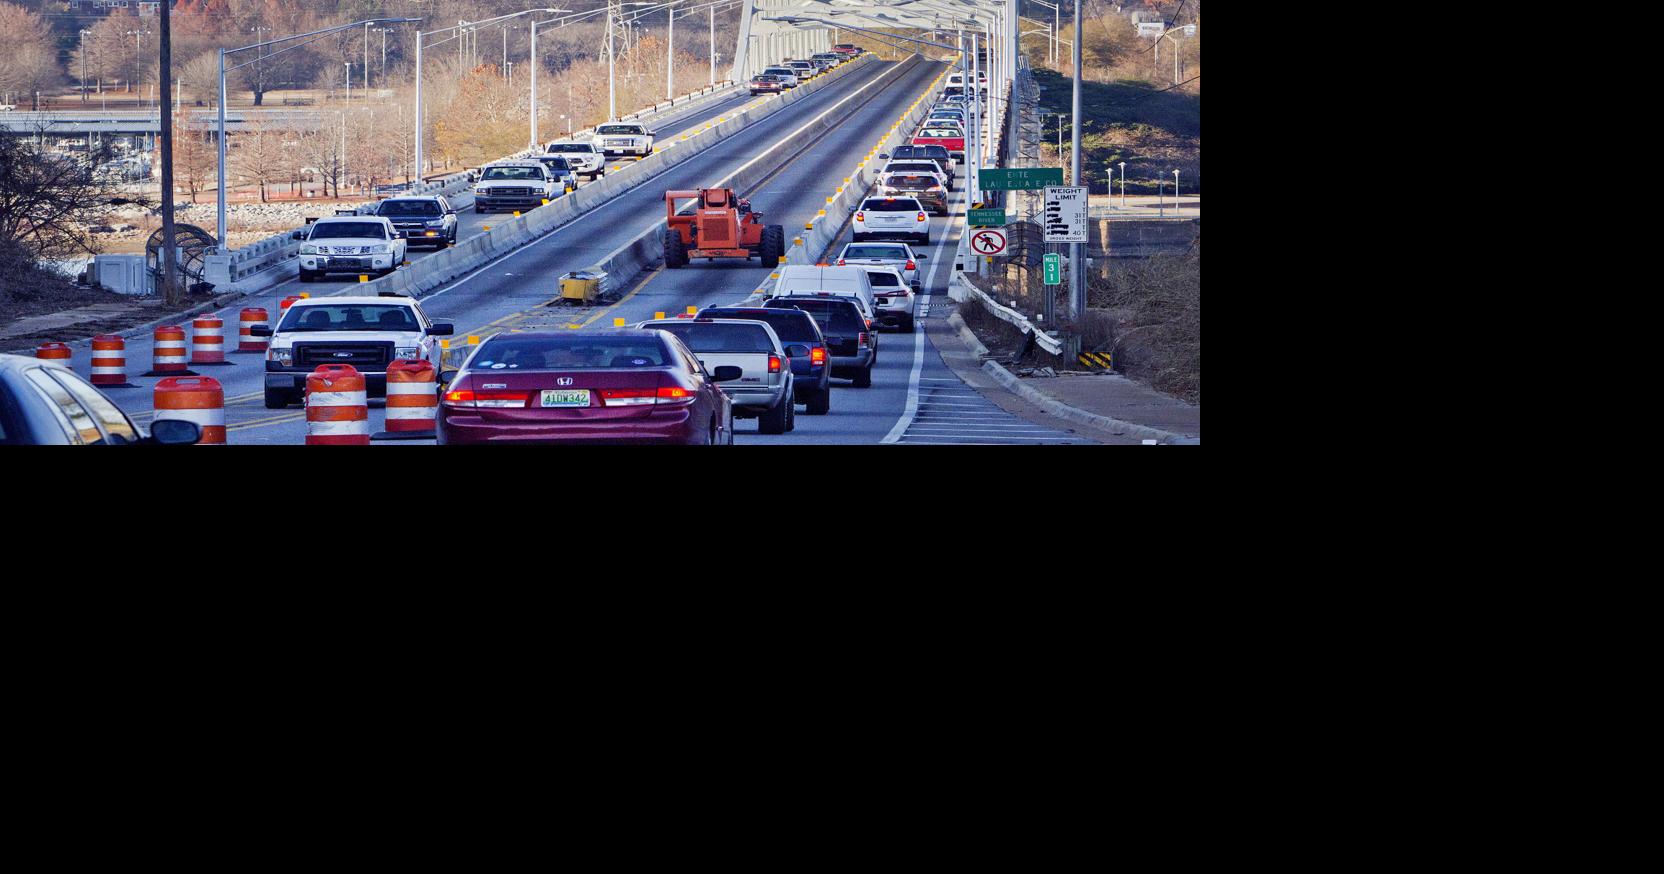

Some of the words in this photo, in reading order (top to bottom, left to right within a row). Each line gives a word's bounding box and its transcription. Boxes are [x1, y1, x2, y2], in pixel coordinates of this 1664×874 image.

[1048, 263, 1055, 272] 3
[1050, 273, 1054, 281] 1
[544, 393, 586, 403] 41DW342
